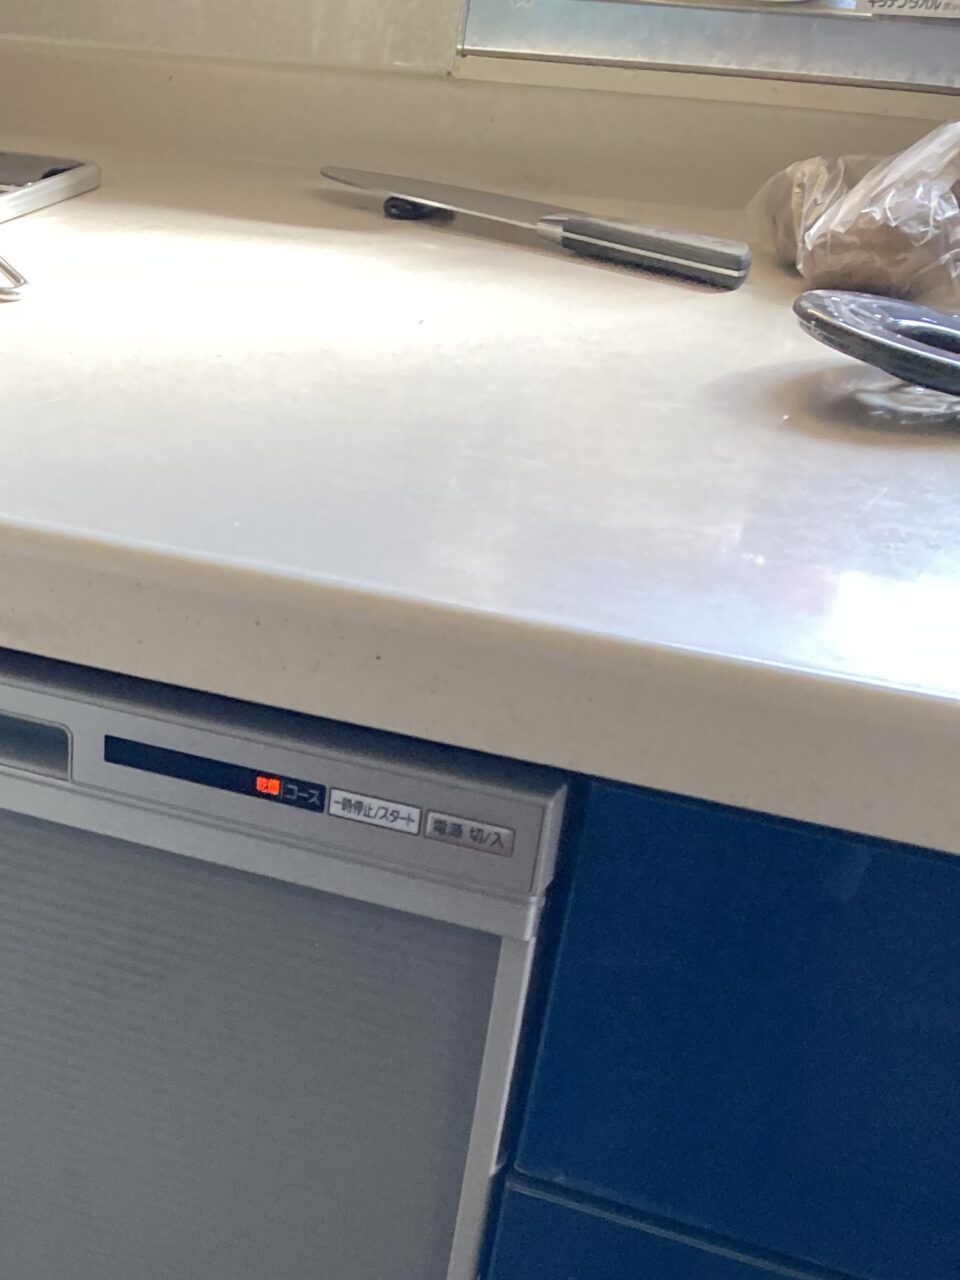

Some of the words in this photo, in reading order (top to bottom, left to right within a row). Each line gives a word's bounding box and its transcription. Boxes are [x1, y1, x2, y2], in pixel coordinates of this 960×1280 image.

[285, 784, 320, 805] コース
[333, 796, 415, 827] 一時停止/スタート
[469, 826, 505, 849] 切/入
